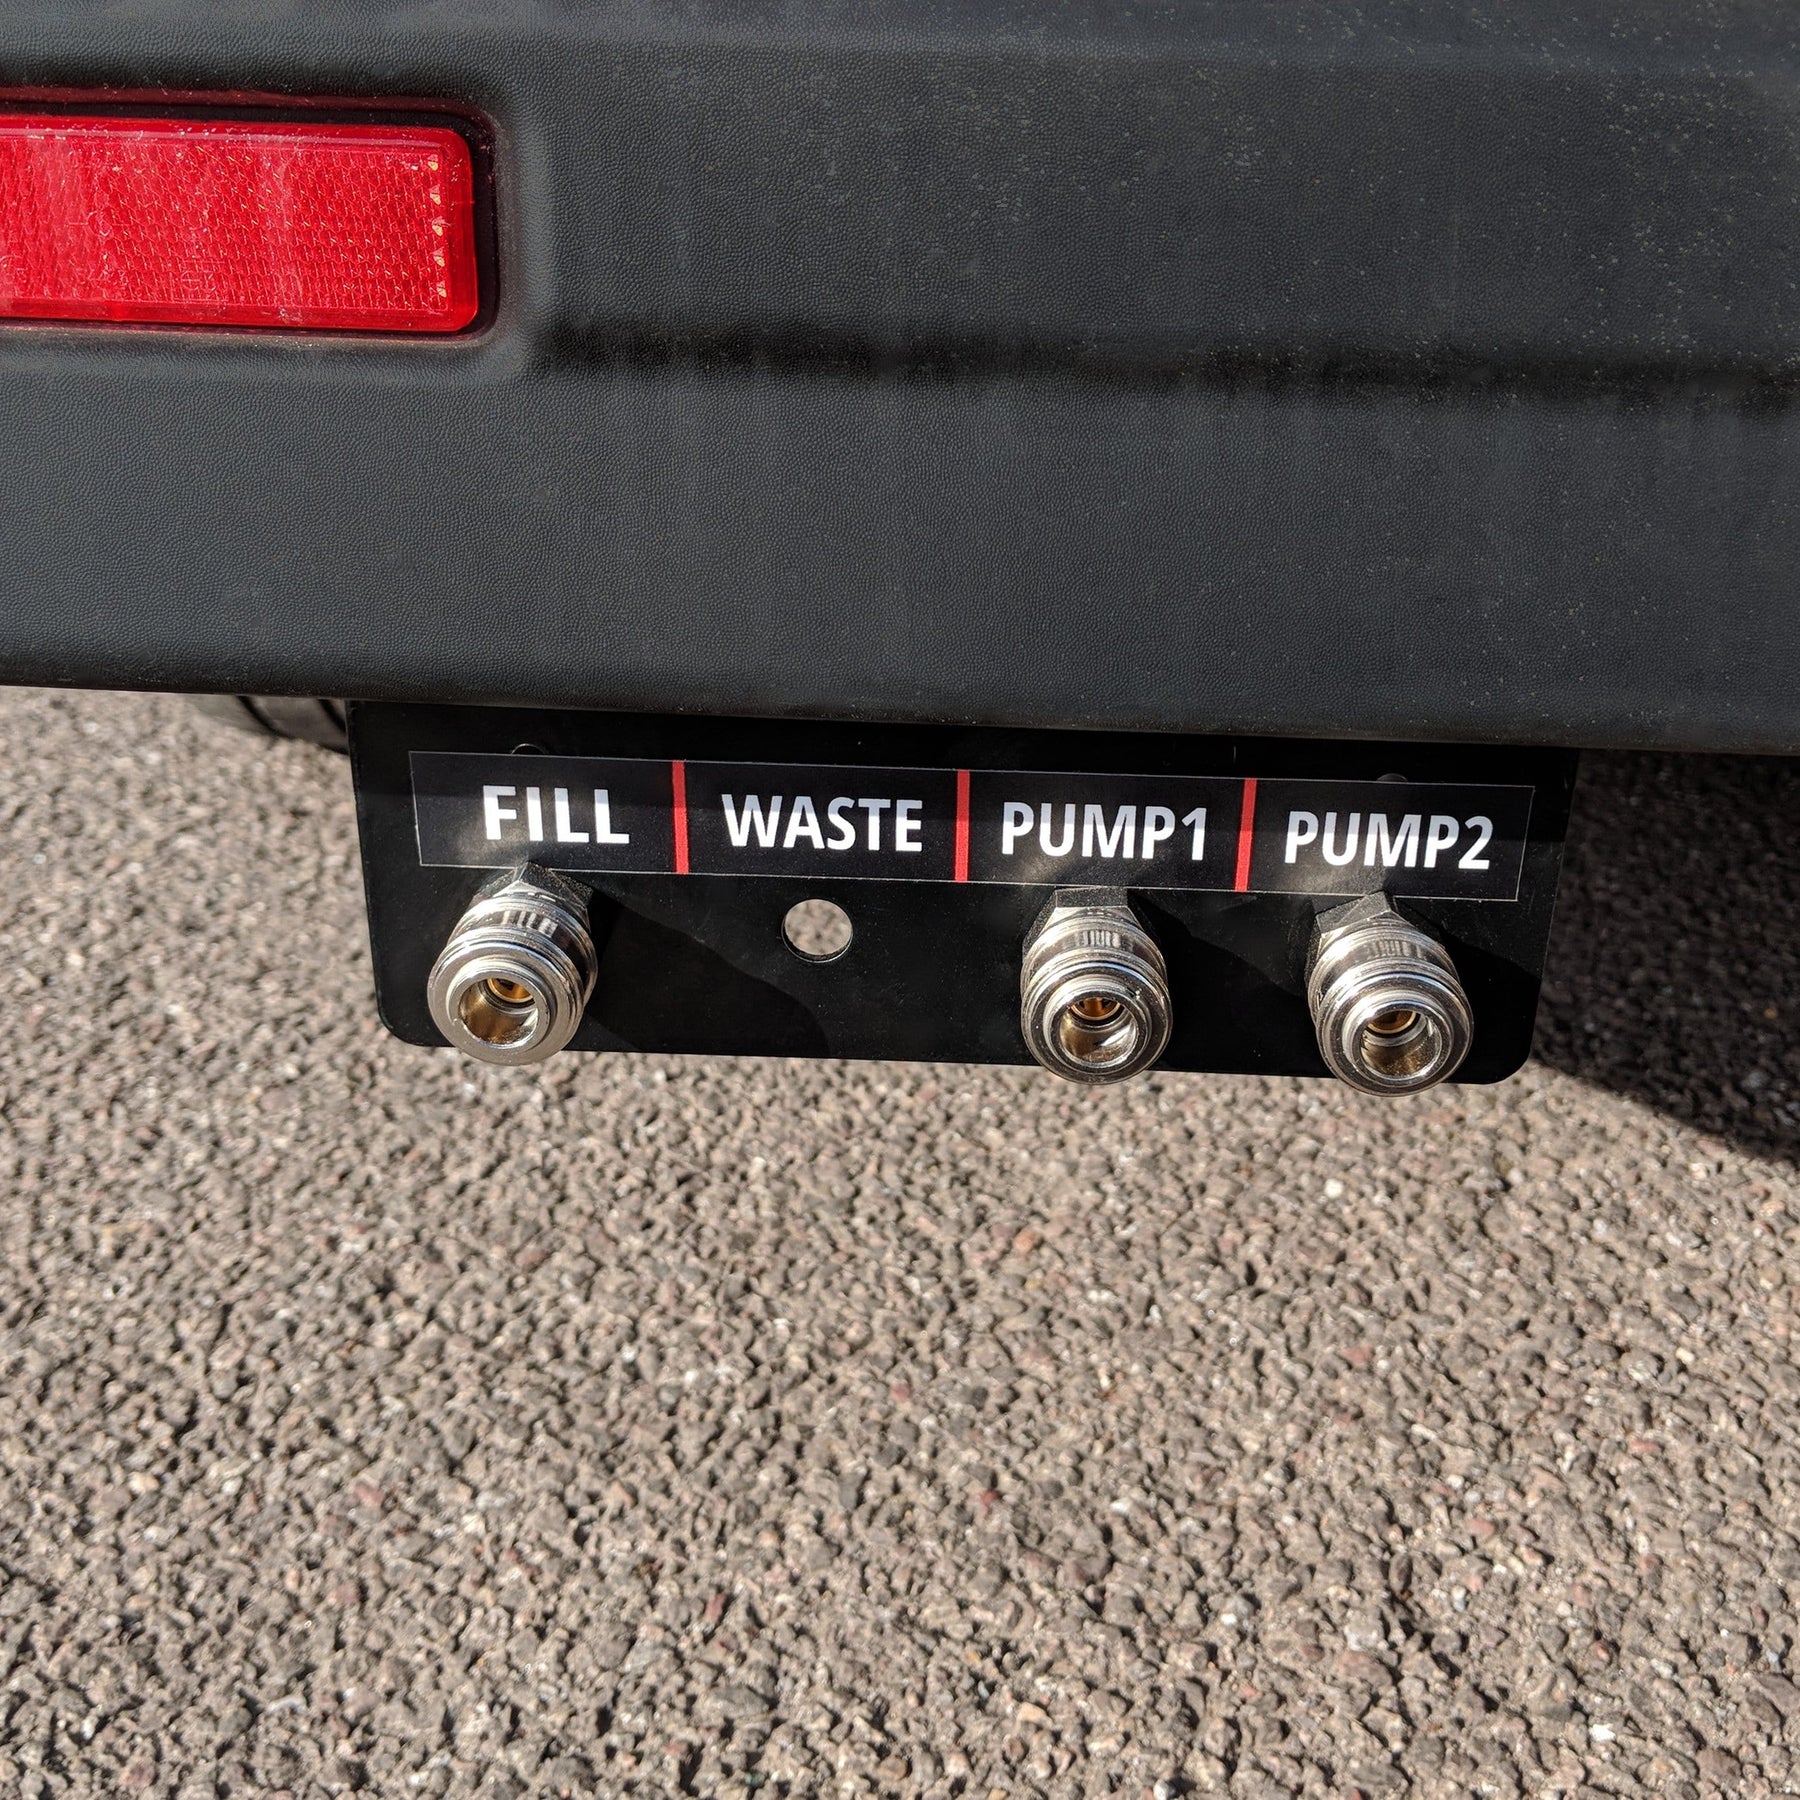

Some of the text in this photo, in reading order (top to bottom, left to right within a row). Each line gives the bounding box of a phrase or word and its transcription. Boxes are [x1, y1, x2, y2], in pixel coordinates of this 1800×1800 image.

[483, 786, 629, 844] FILL
[722, 795, 922, 852] WASTE
[1002, 803, 1206, 860] PUMP1
[1285, 812, 1492, 869] PUMP2
